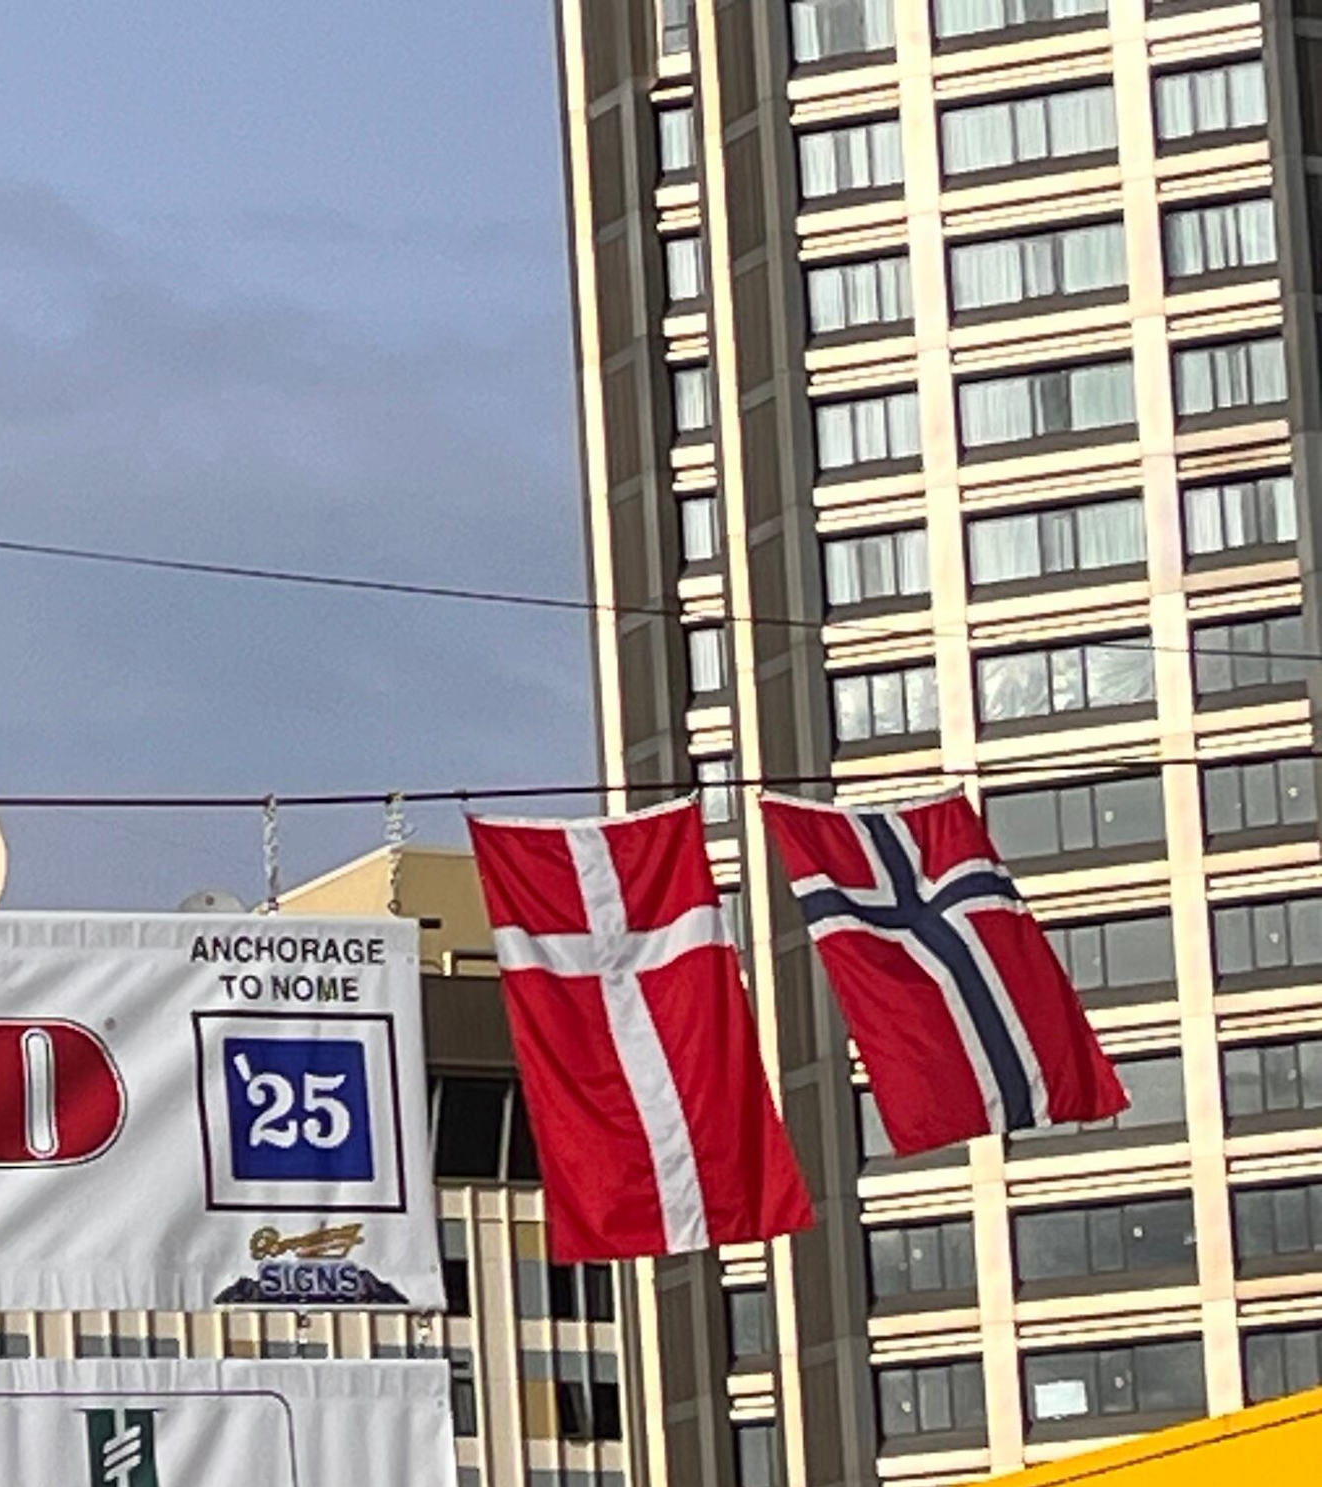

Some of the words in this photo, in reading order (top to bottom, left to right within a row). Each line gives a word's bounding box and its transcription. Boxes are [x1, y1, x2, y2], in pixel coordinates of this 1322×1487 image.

[189, 934, 386, 965] ANCHORAGE
[219, 974, 265, 1002] TO
[271, 974, 361, 1003] NOME
[259, 1262, 361, 1294] SIGNS
